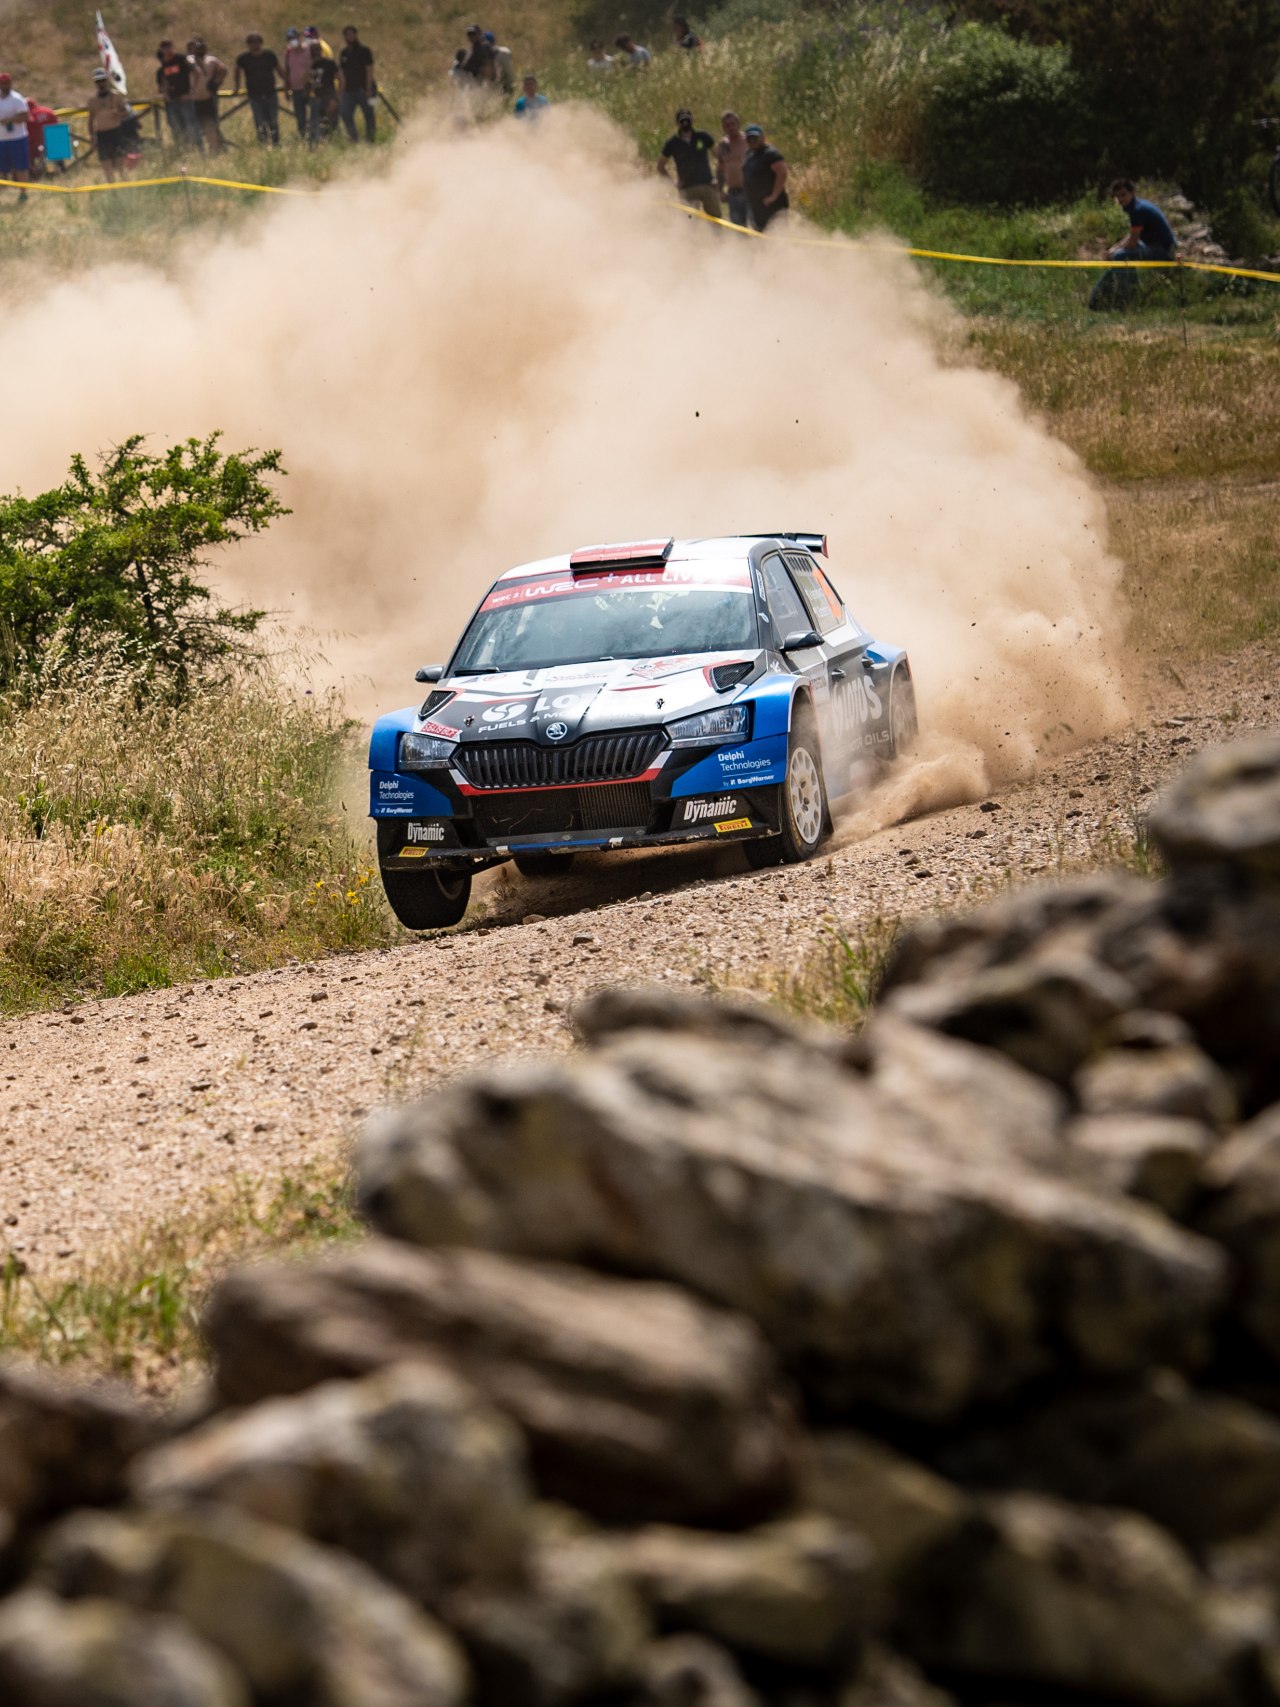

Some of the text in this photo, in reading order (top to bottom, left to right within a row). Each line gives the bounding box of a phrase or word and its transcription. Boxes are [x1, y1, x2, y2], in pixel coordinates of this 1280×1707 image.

[620, 573, 656, 585] ALL
[478, 719, 526, 734] FUELS
[864, 730, 890, 746] OILS
[717, 750, 745, 762] Delphi
[720, 758, 772, 772] Technologies
[379, 780, 399, 790] Delphi
[737, 774, 775, 785] BorgWarner
[379, 790, 415, 801] Technologies
[683, 795, 737, 823] Dynamic
[718, 820, 748, 831] PIRELLI
[407, 822, 445, 843] Dynamic
